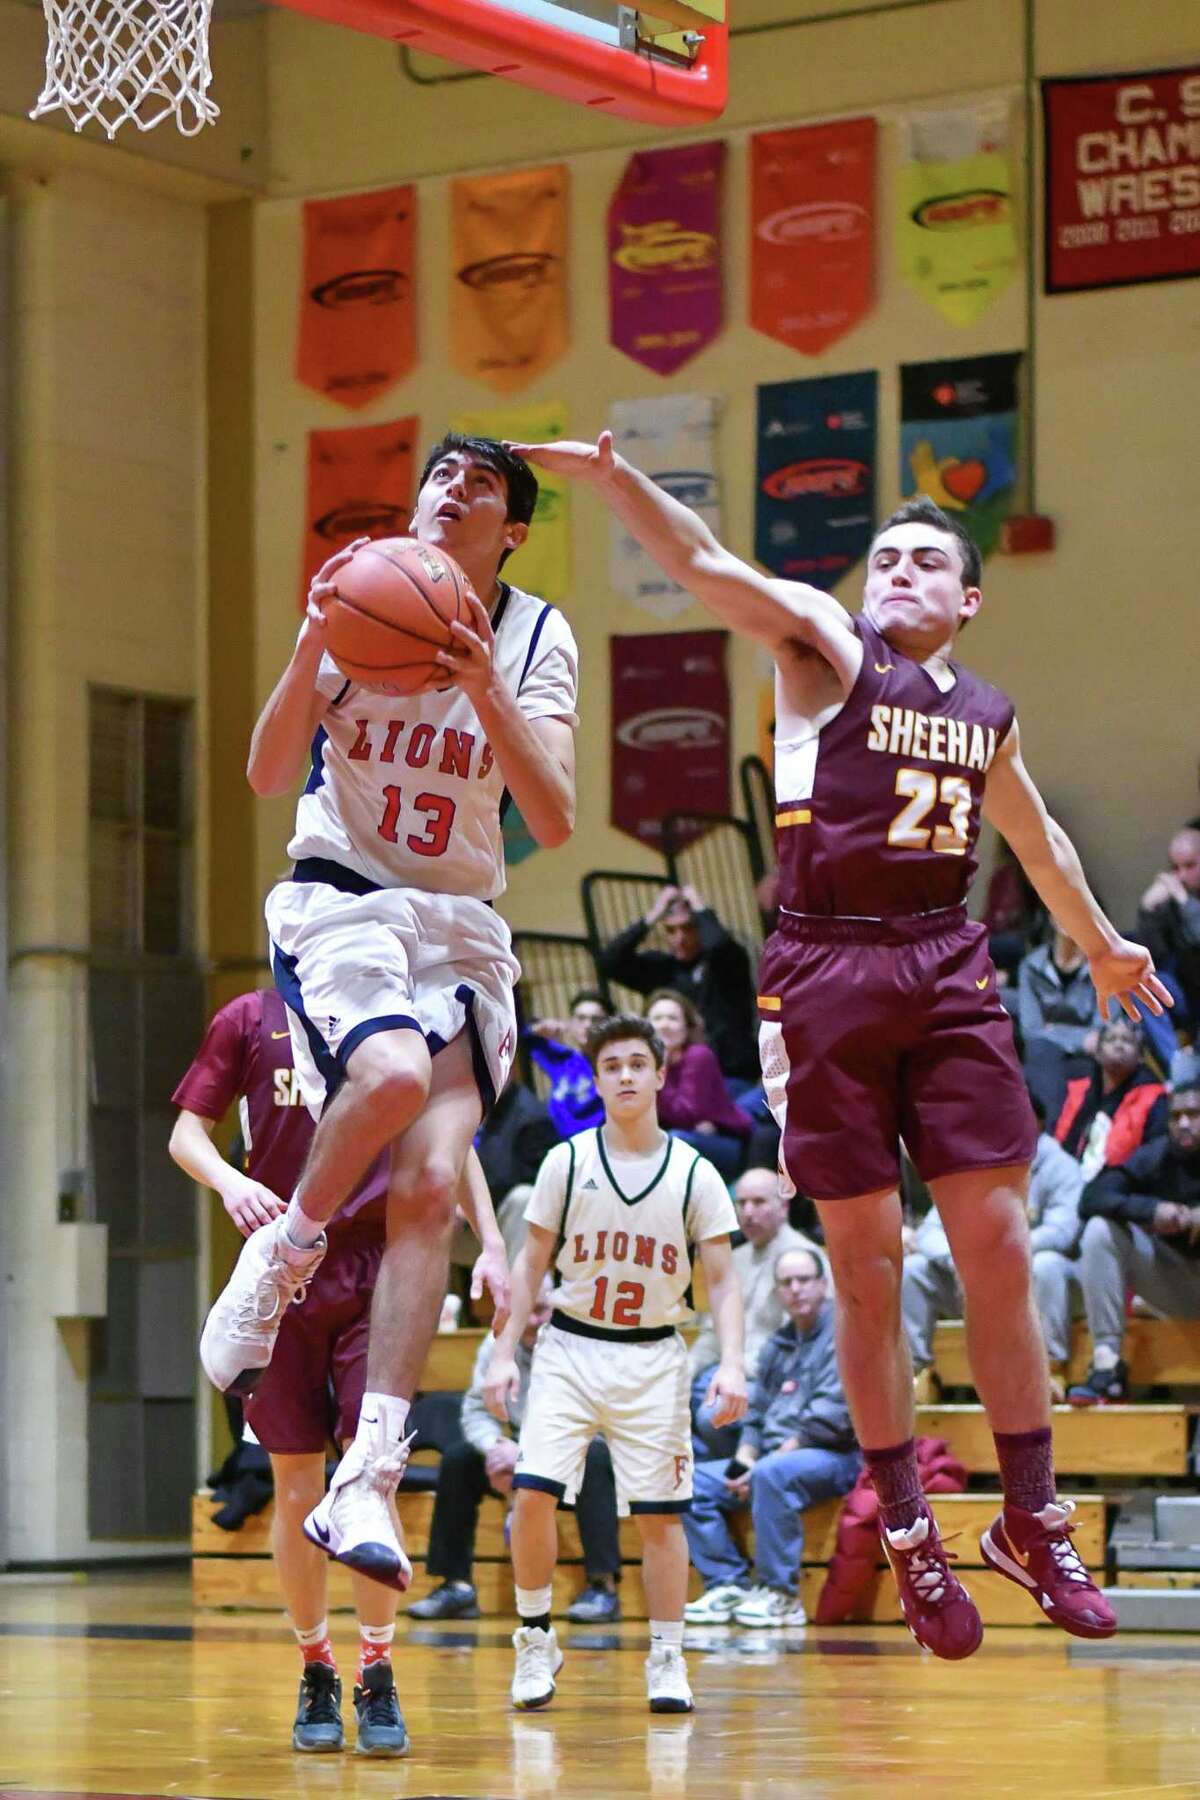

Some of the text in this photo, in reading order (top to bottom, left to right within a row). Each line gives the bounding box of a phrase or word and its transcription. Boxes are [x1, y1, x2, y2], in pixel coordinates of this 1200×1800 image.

[1076, 164, 1200, 219] WRES
[348, 719, 495, 780] LIONS
[377, 784, 457, 857] 13
[887, 768, 972, 856] 23
[573, 1230, 678, 1275] LIONS
[589, 1275, 645, 1326] 12
